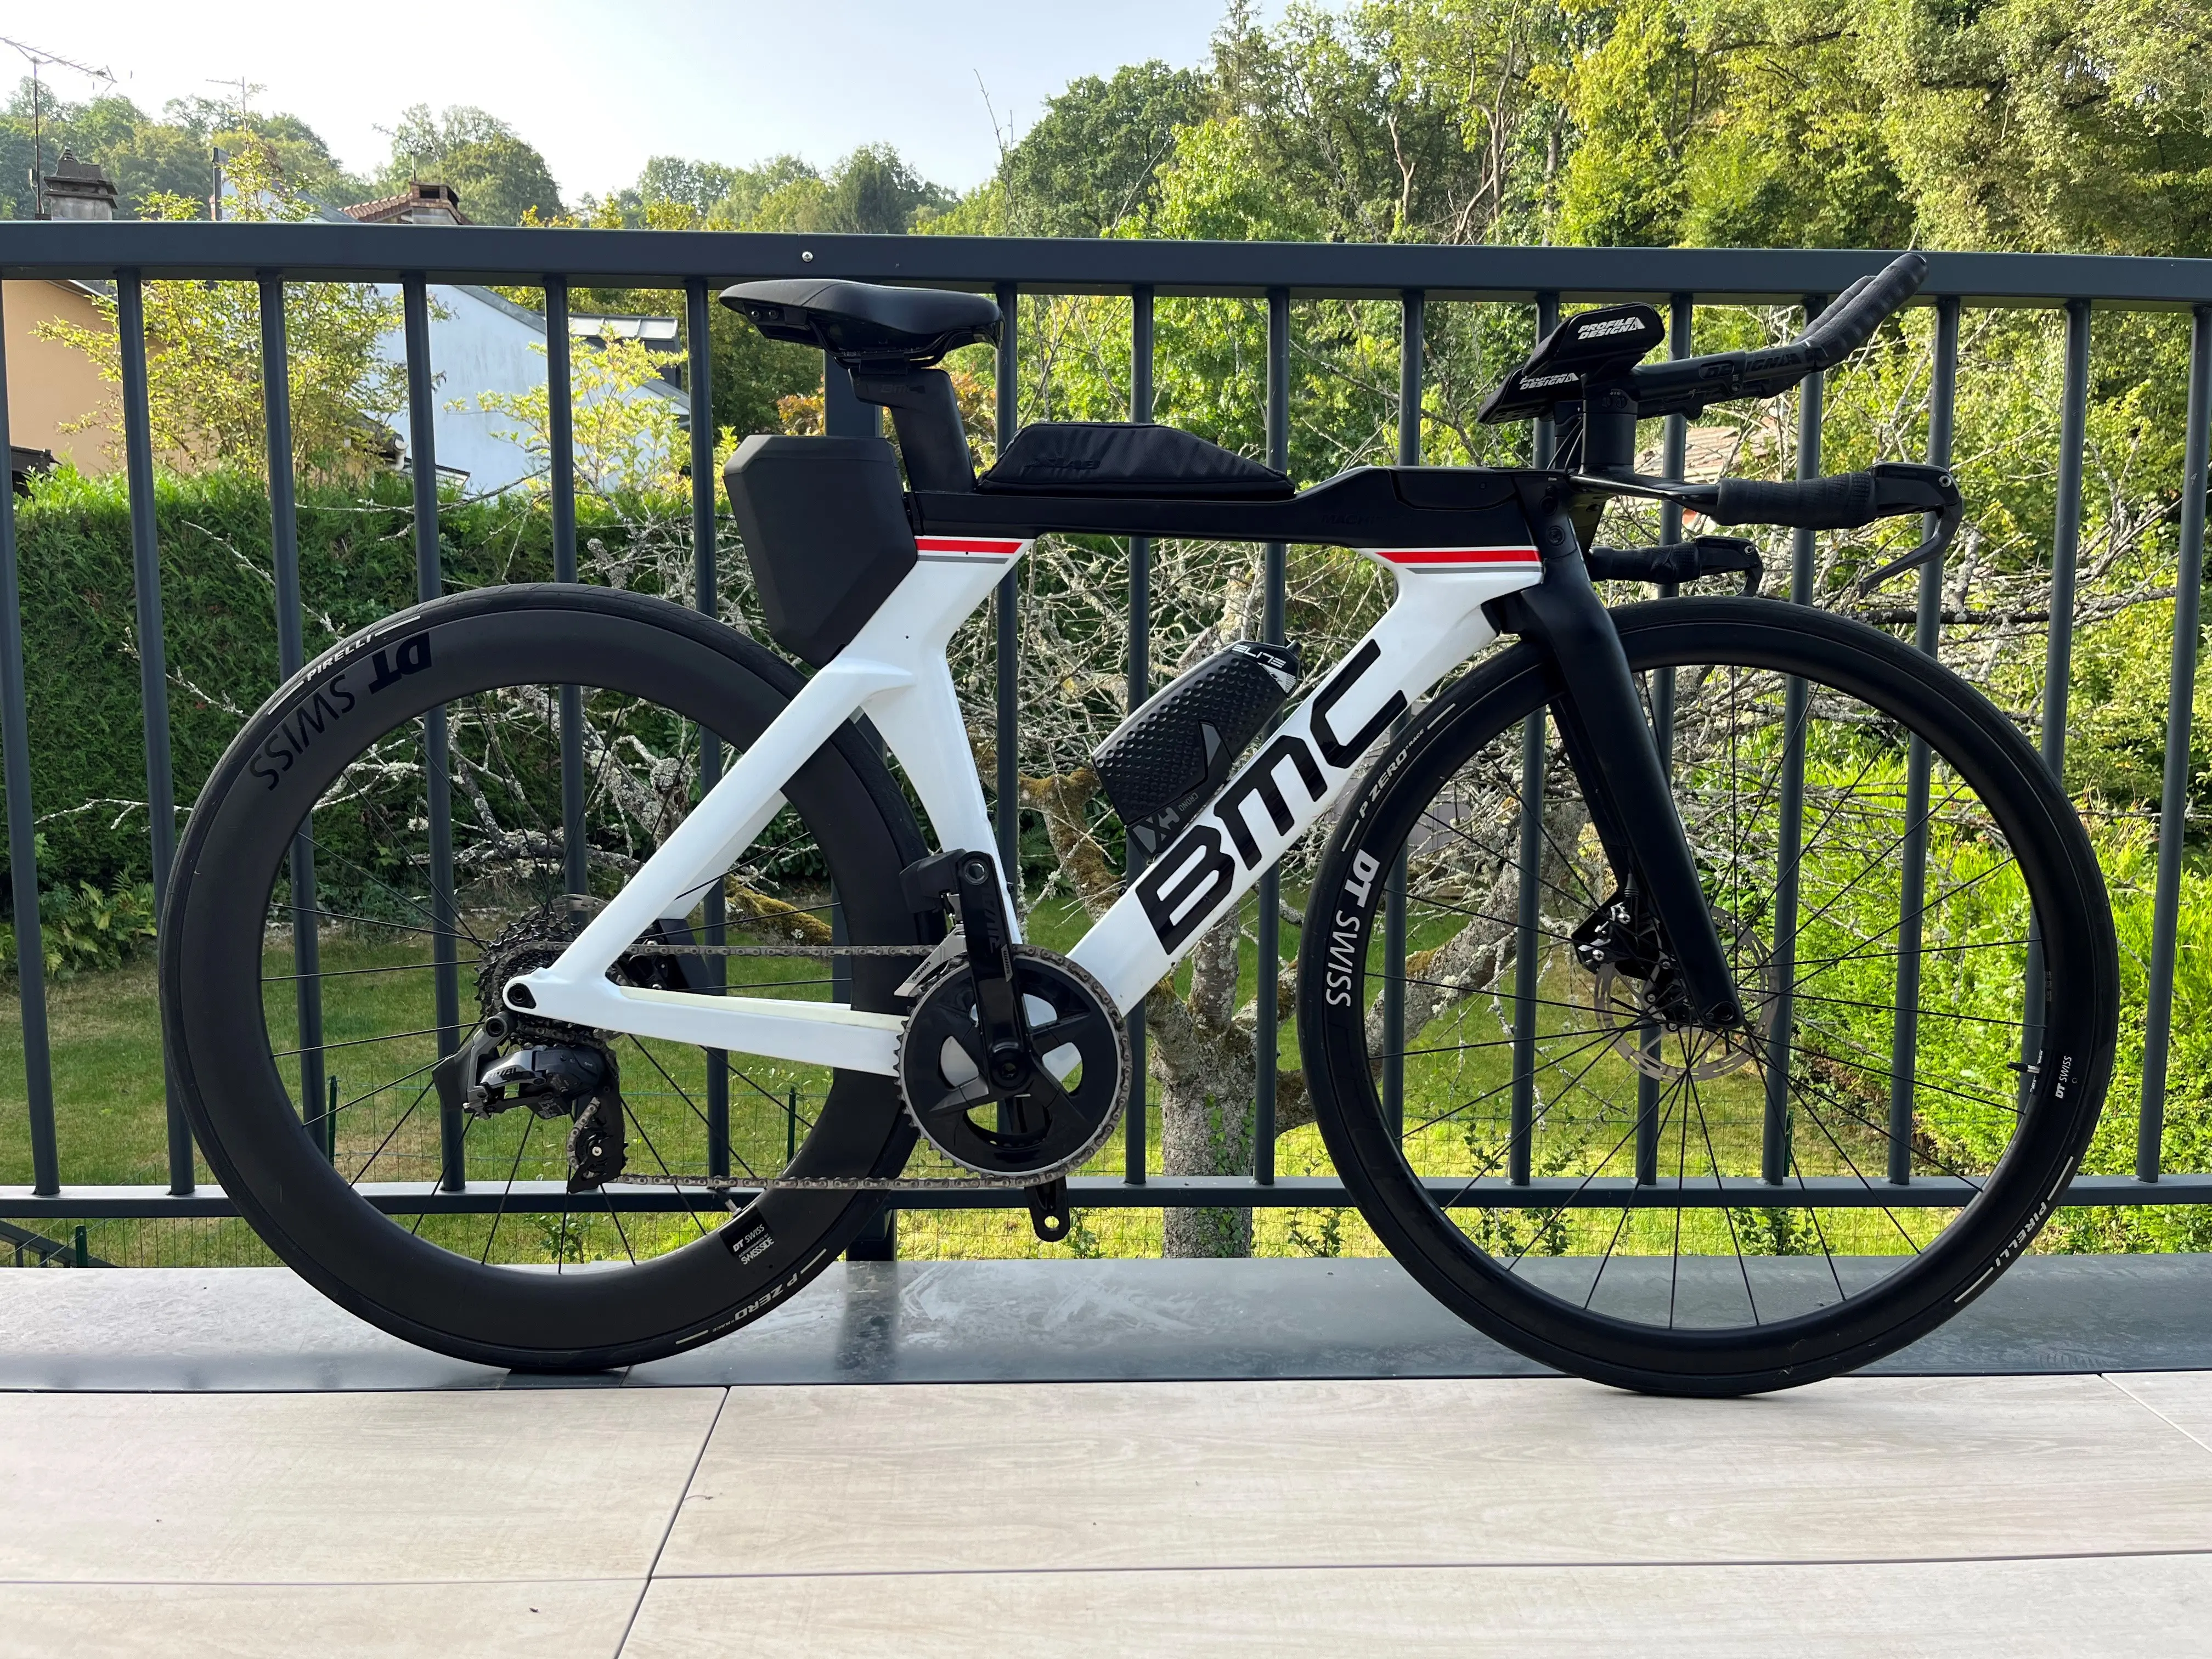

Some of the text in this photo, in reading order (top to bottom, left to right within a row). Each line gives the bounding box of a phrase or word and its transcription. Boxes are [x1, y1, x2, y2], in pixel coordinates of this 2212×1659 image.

[1578, 317, 1635, 334] PROFILE
[307, 634, 371, 681] PIRELLI
[1232, 644, 1286, 668] ELITE
[250, 632, 432, 791] DT SWISS
[1136, 638, 1408, 955] BMC
[1178, 792, 1199, 812] CRONO
[1359, 801, 1369, 819] P
[1369, 748, 1408, 802] ZERO
[1325, 849, 1380, 1007] DT SWISS
[912, 961, 931, 981] SRAM
[2055, 1056, 2072, 1099] DT SWISS
[732, 1224, 765, 1252] DT SWISS
[1995, 1201, 2047, 1267] PIRELLI
[787, 1272, 798, 1287] P
[735, 1284, 784, 1321] ZERO
